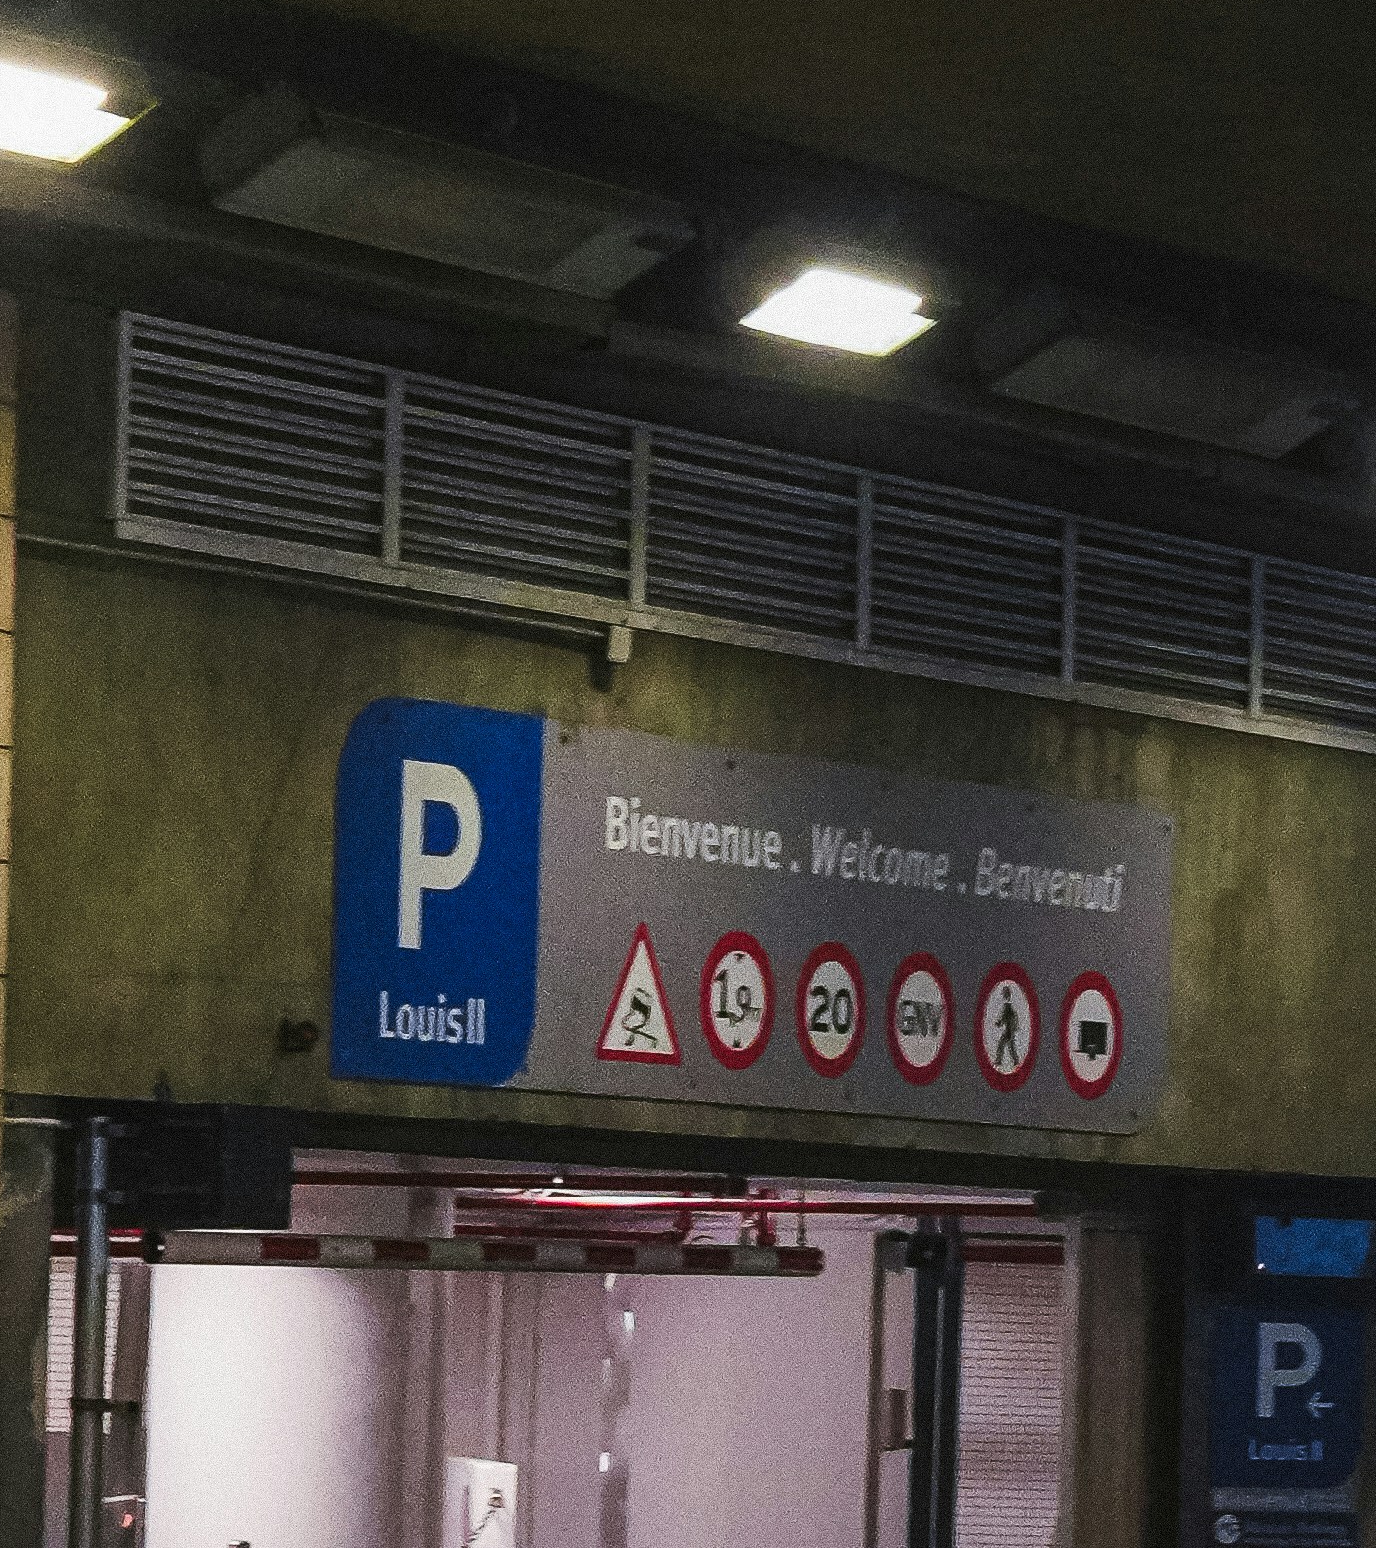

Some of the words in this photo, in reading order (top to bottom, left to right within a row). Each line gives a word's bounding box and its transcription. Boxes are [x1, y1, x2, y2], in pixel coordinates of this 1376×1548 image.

[398, 759, 483, 950] P
[605, 796, 784, 870] Bienvenue
[811, 823, 949, 892] Welcome
[809, 985, 853, 1035] 20
[1255, 1322, 1323, 1418] P
